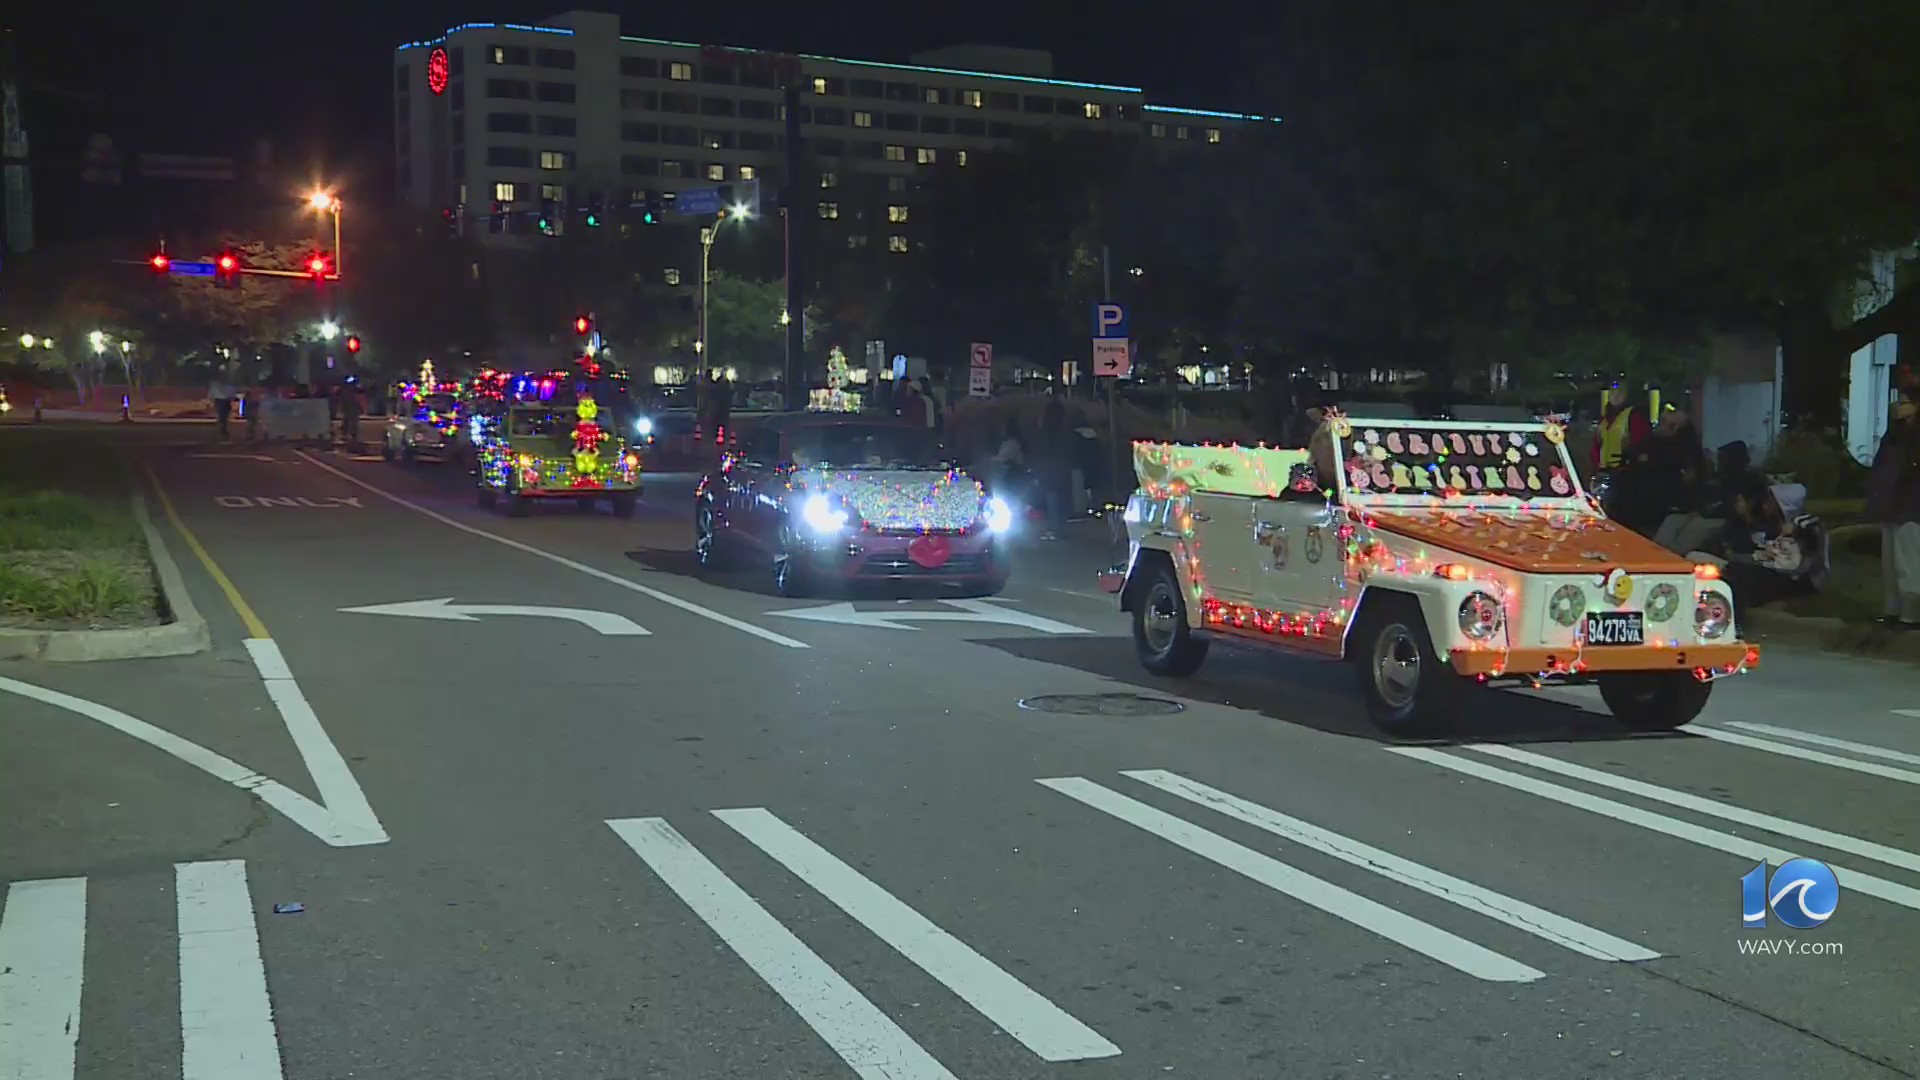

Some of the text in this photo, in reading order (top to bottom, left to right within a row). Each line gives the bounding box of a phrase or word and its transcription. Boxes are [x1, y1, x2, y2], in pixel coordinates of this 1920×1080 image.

[1098, 304, 1123, 337] P
[1370, 462, 1542, 491] CHRISTMAS
[214, 495, 364, 508] ONLY
[1588, 619, 1627, 642] 94273
